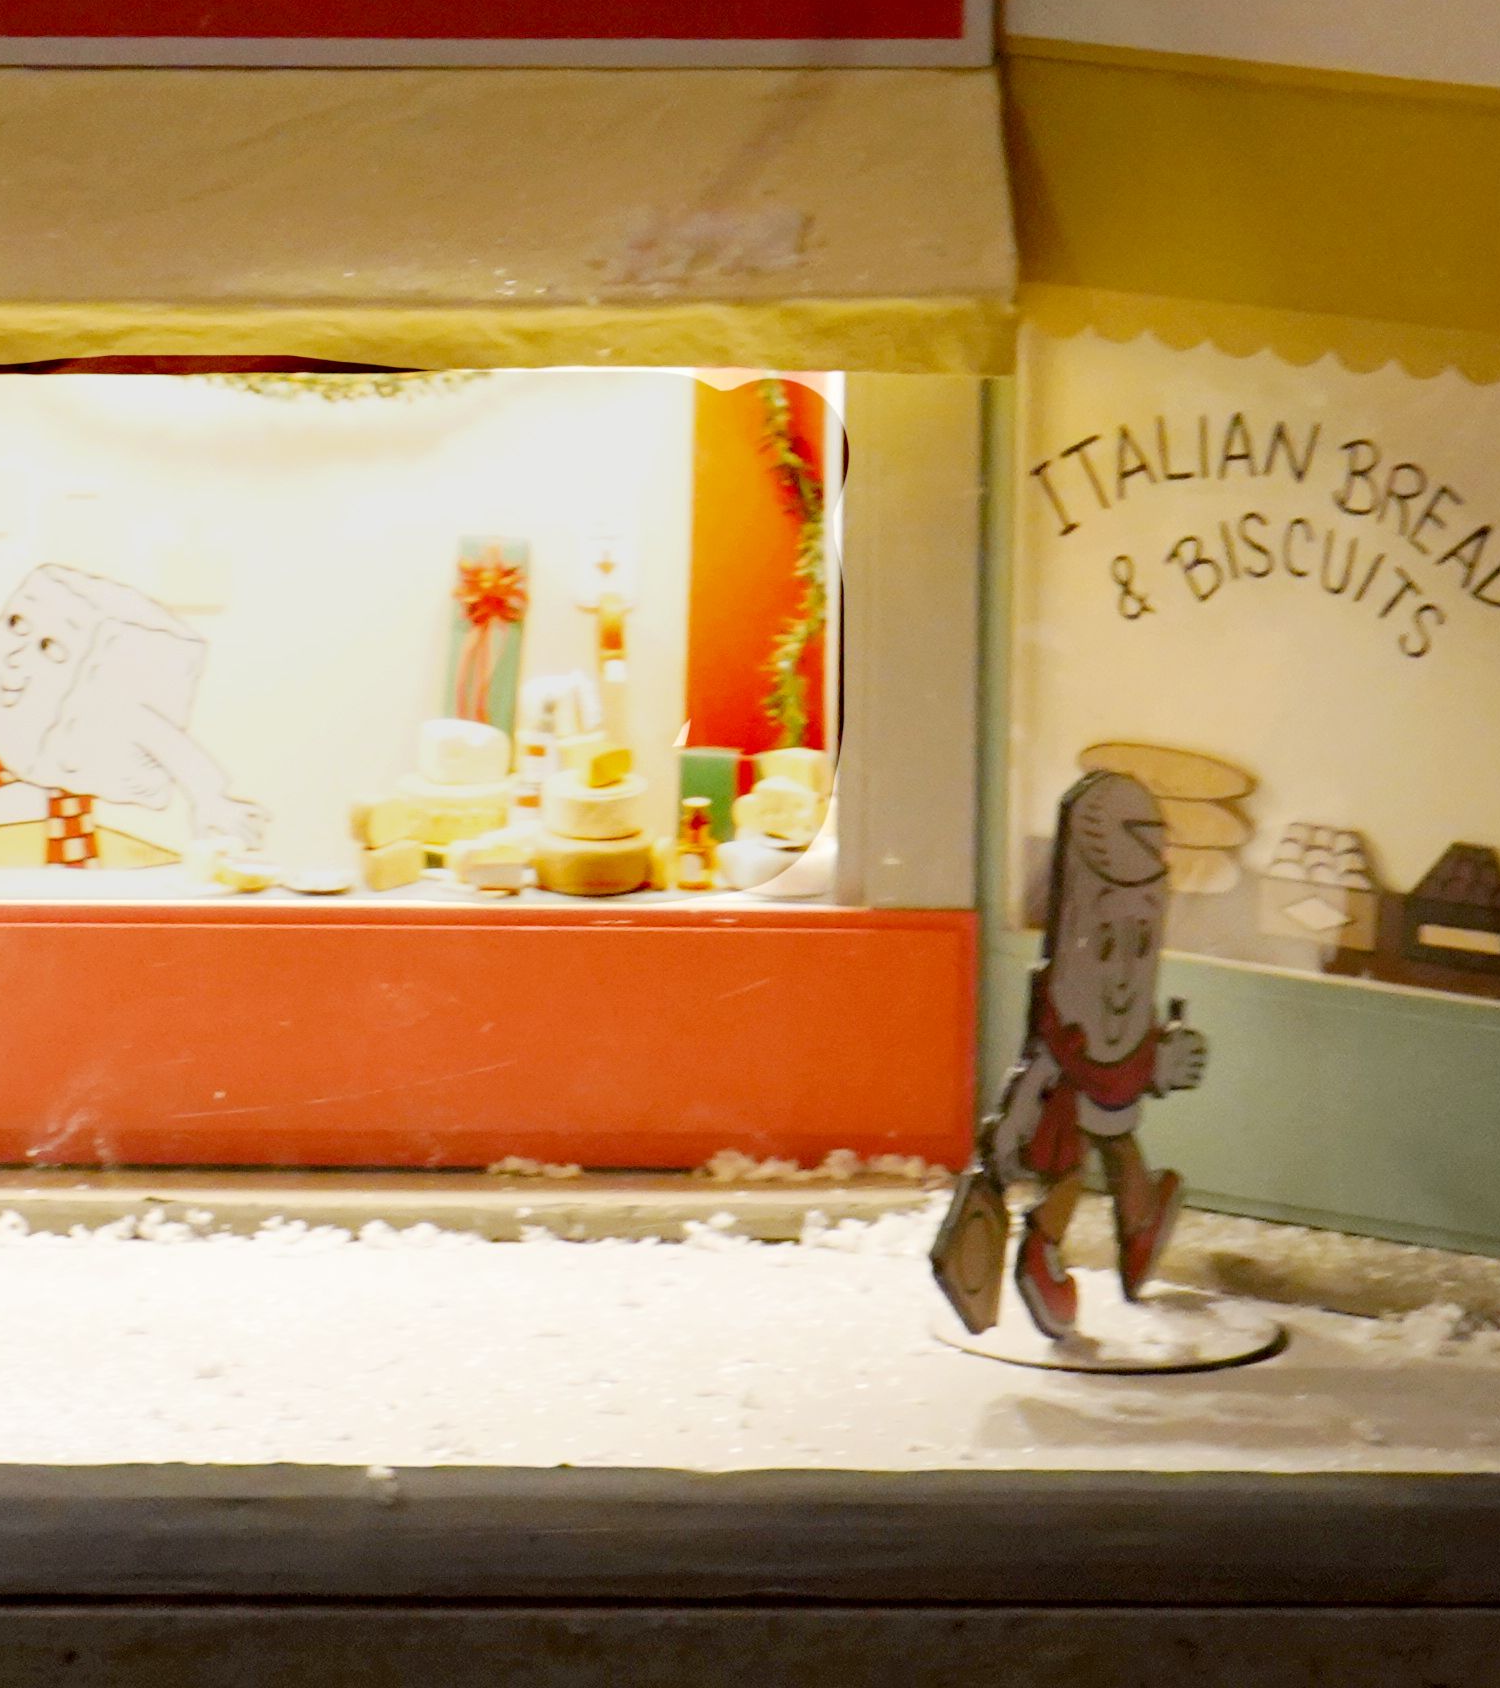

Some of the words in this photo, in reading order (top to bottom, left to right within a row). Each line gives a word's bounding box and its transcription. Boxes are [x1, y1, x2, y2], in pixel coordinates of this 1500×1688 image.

[1031, 412, 1321, 536] ITALIAN
[1110, 555, 1155, 619] &
[1164, 512, 1446, 657] BISCUITS
